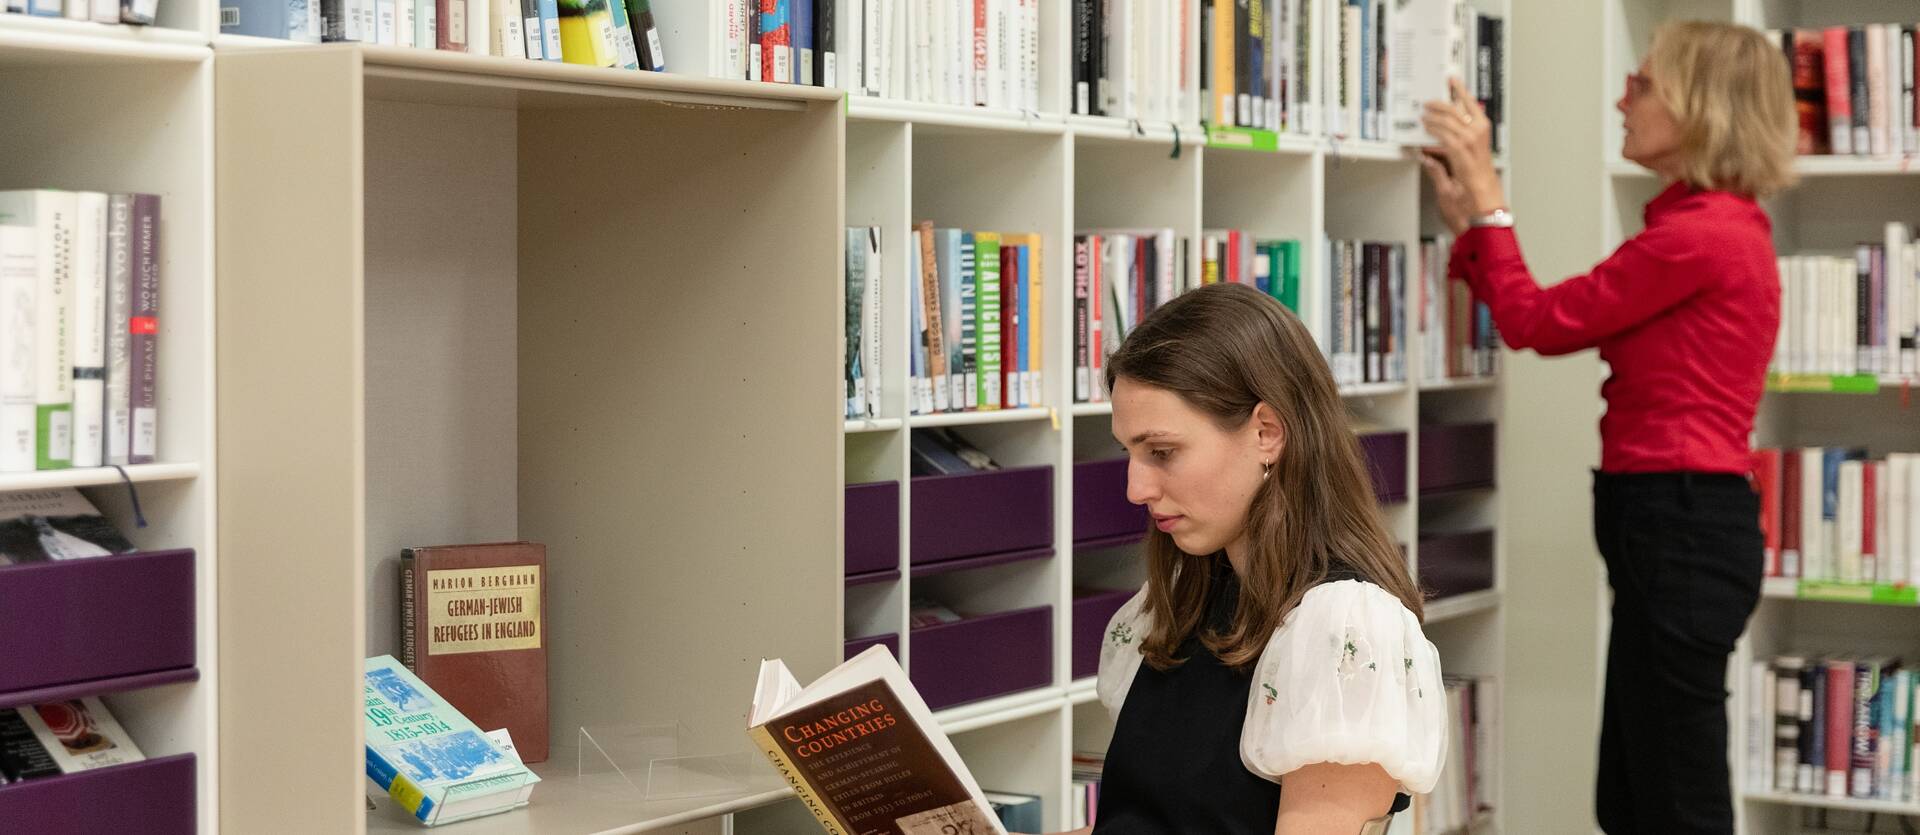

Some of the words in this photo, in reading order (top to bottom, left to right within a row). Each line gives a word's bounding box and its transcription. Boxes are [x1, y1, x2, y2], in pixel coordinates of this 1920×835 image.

[108, 201, 129, 281] vorbei
[143, 215, 153, 255] IMMER
[142, 257, 152, 289] AUCH
[1075, 242, 1088, 299] PHLOX
[114, 287, 128, 306] es
[142, 291, 151, 312] WO
[109, 310, 127, 369] wäre
[144, 339, 154, 382] PHAM
[432, 576, 474, 591] MARION
[481, 573, 536, 588] BERGHAHN
[447, 596, 523, 617] GERMAN-JEWISH
[433, 623, 479, 643] REFUGEES
[481, 622, 492, 640] IN
[494, 620, 536, 639] ENGLAND
[783, 698, 885, 744] CHANGING
[796, 712, 897, 759] COUNTRIES
[808, 759, 825, 771] THE
[826, 743, 873, 764] EXPERIENCE
[817, 769, 835, 781] AND
[837, 750, 890, 773] ACHIEVEMENT
[768, 750, 824, 817] CHANGING
[824, 760, 899, 792] GERMAN-SPEAKING
[860, 780, 882, 792] FROM
[884, 769, 912, 784] HITLER
[849, 810, 873, 823] FROM
[873, 803, 895, 816] 1933
[906, 789, 935, 804] TODAY
